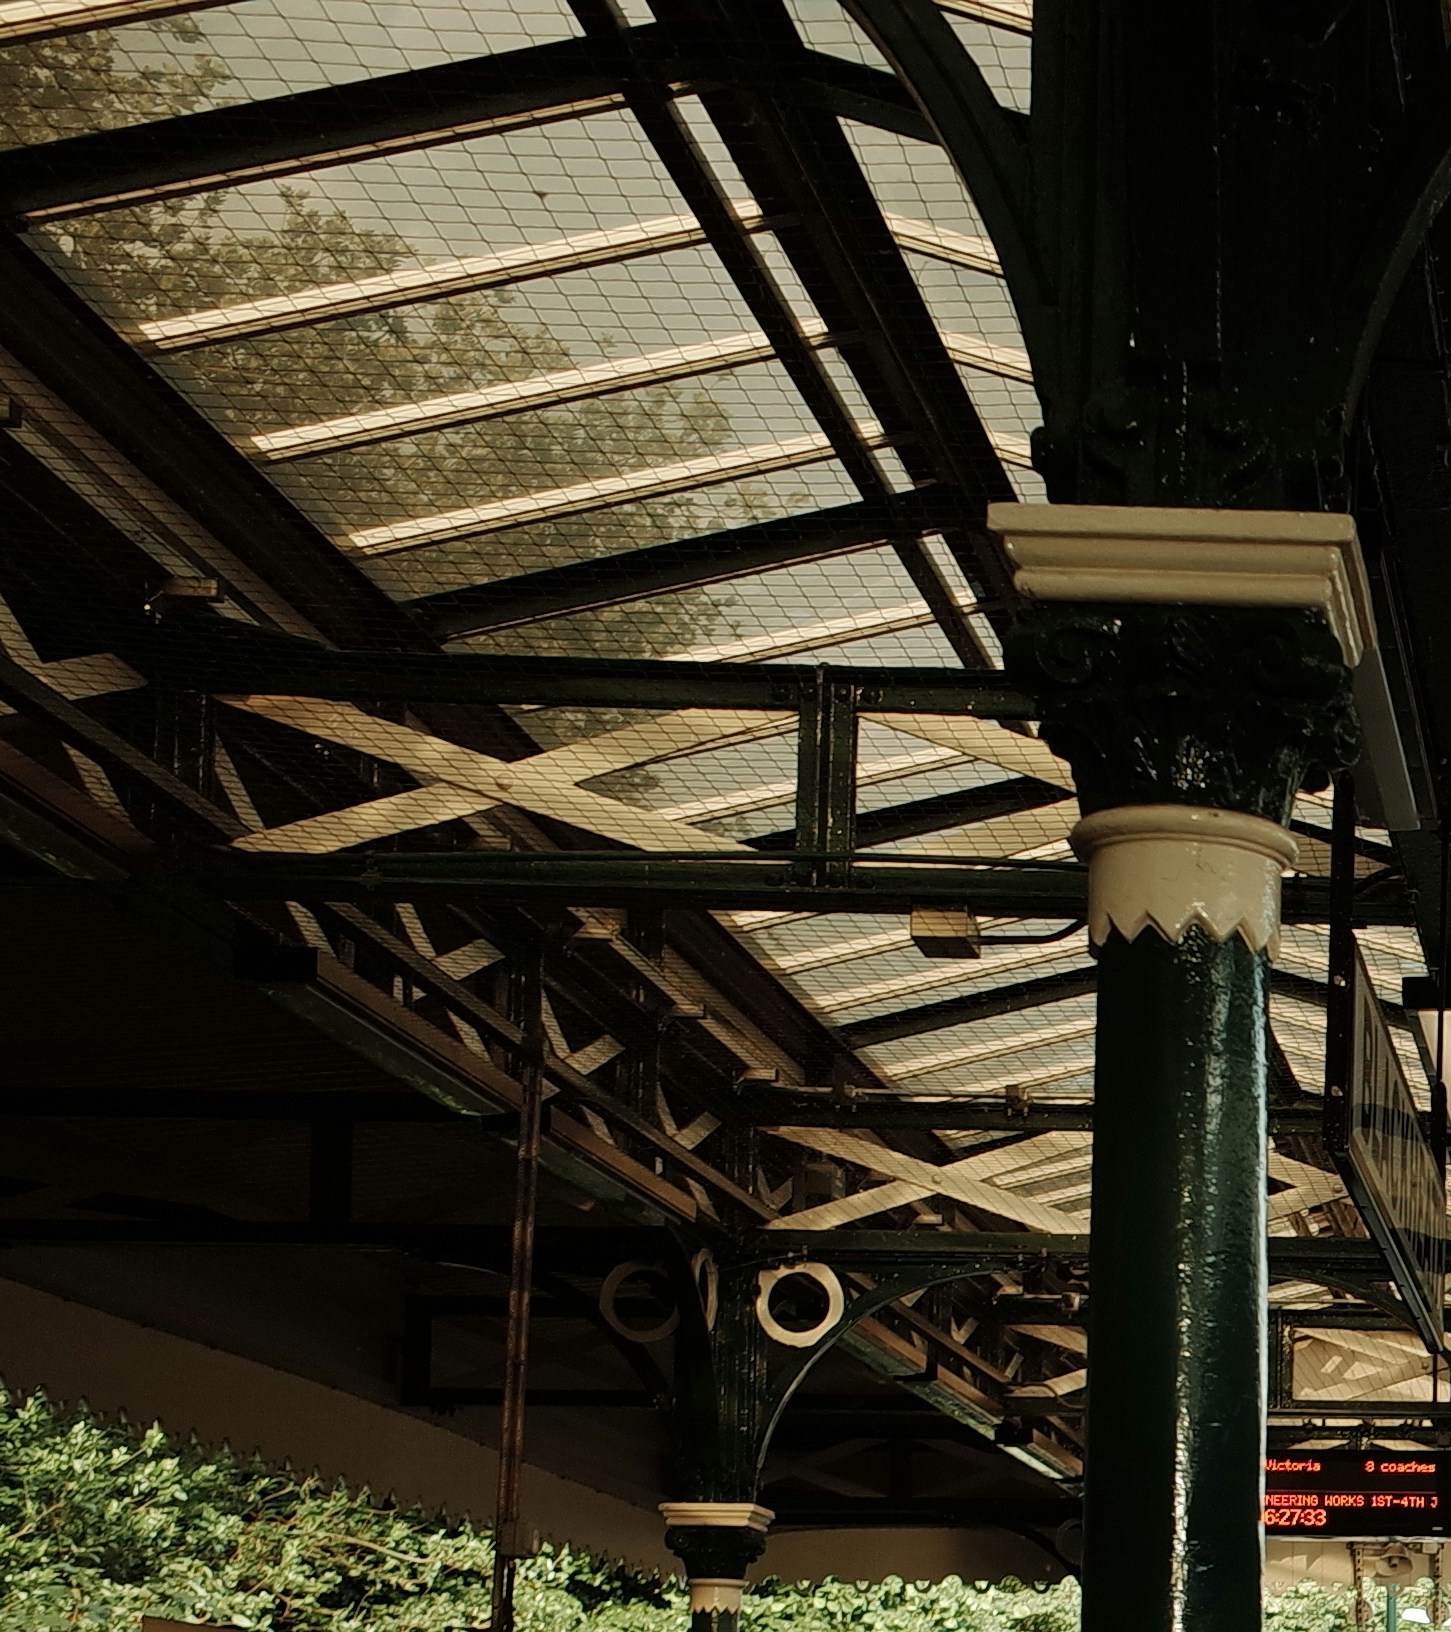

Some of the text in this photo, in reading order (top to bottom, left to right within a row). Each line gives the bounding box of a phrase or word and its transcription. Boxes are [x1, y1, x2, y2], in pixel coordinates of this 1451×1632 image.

[1380, 1461, 1436, 1473] coaches
[1264, 1494, 1319, 1507] NEERING
[1325, 1495, 1365, 1507] WORKS
[1371, 1496, 1425, 1508] 1ST-4TH
[1263, 1509, 1327, 1526] 6:27:33
